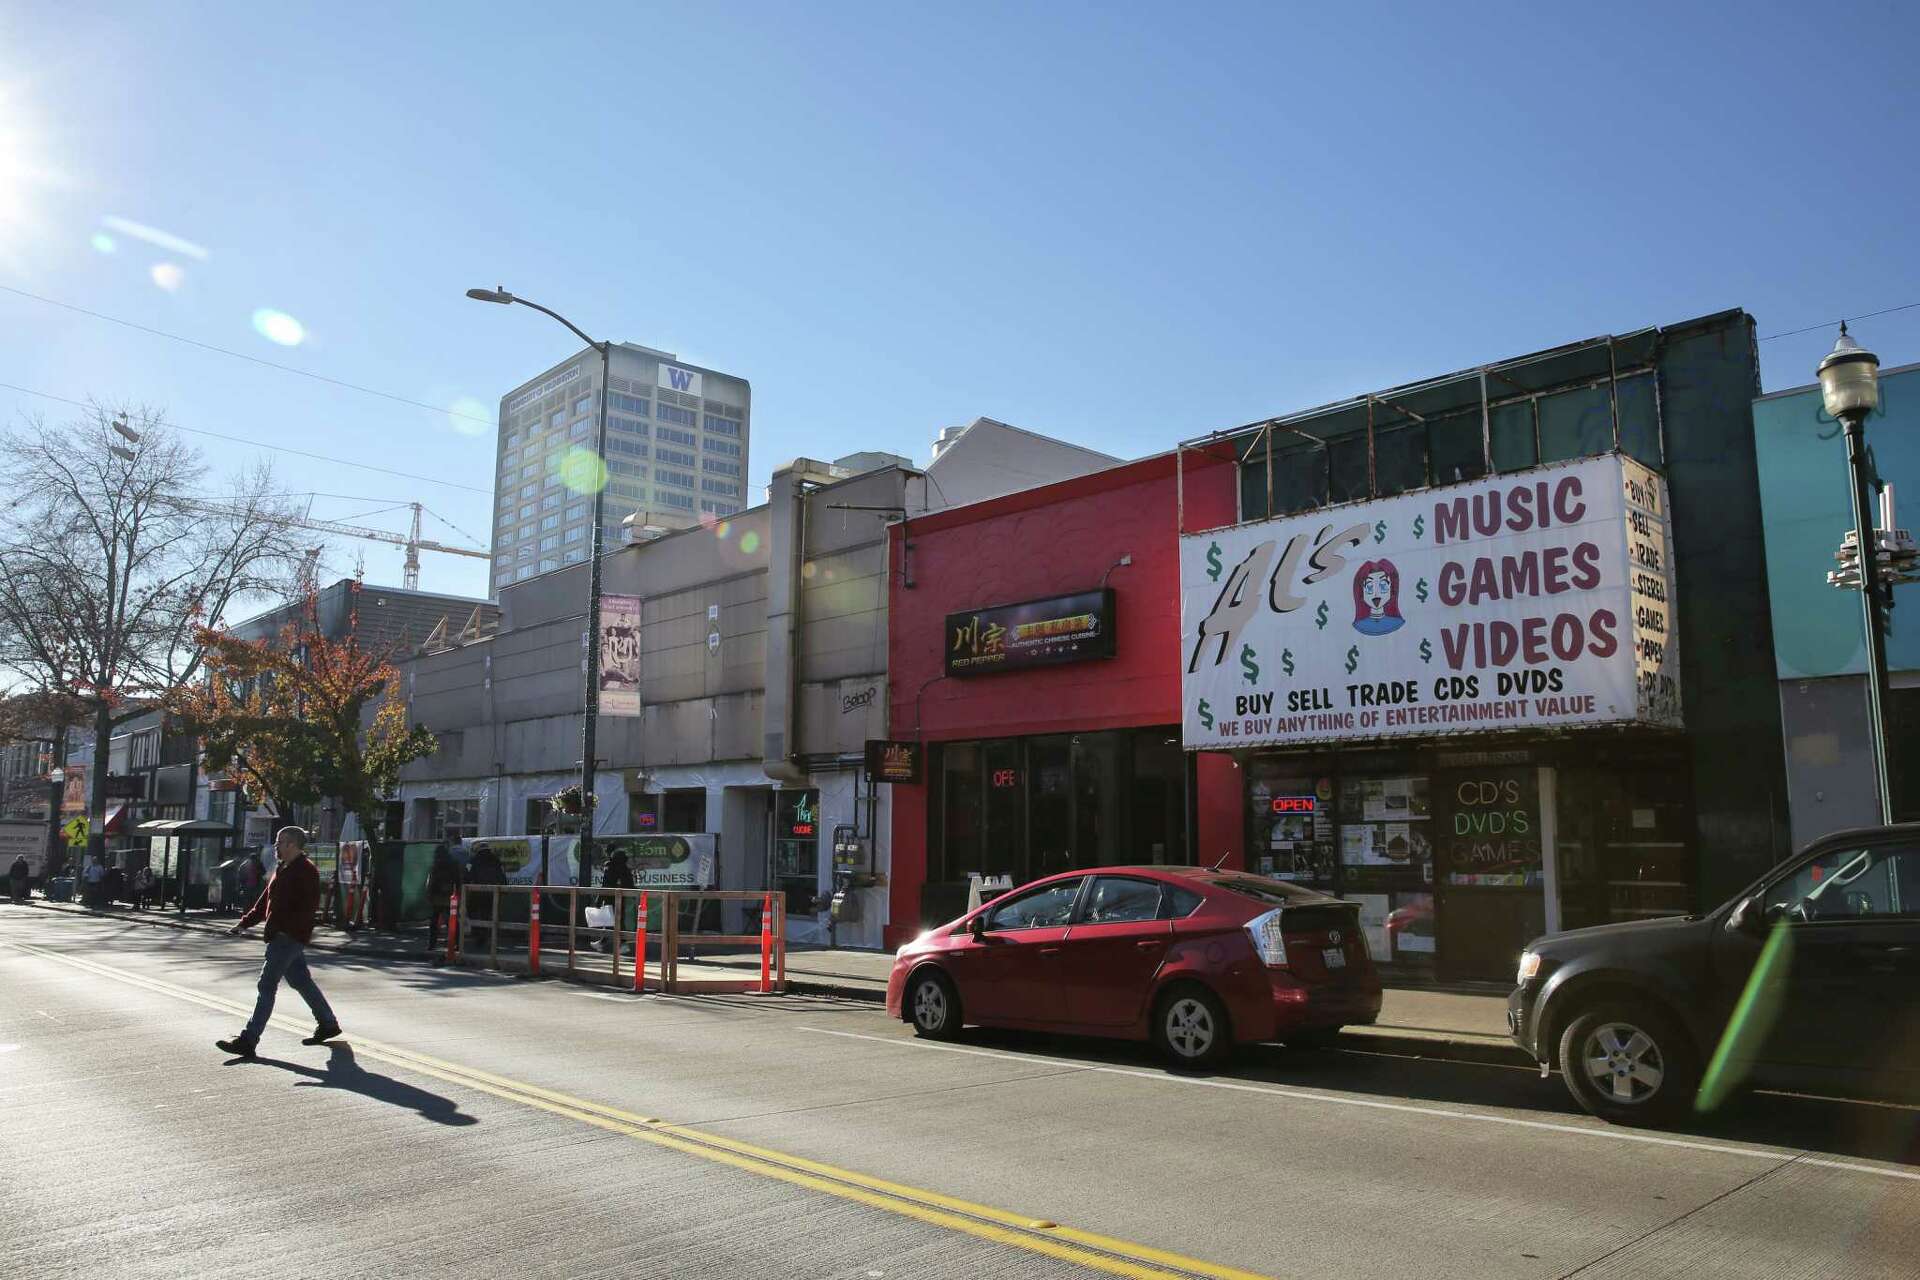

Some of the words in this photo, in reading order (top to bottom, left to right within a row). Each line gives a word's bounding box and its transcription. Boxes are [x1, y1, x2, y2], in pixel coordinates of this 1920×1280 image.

[667, 368, 693, 391] W
[1434, 476, 1586, 544] MUSIC
[1632, 510, 1650, 537] SELL
[1635, 542, 1659, 571] TRADE
[1438, 542, 1600, 606] GAMES
[1637, 575, 1665, 603] STEREO
[1638, 607, 1664, 633] GAMES
[1440, 609, 1617, 670] VIDEOS
[1640, 638, 1663, 664] TAPES
[1236, 692, 1274, 716] BUY
[1288, 688, 1333, 712] SELL
[1347, 680, 1418, 707] TRADE
[1434, 675, 1479, 700] CDS
[1497, 668, 1563, 696] DVDS
[1220, 721, 1238, 737] WE
[1245, 720, 1272, 735] BUY
[1277, 712, 1354, 734] ANYTHING
[1360, 710, 1379, 727] OF
[1386, 699, 1528, 726] ENTERTAINMENT
[1535, 695, 1597, 717] VALUE
[1273, 799, 1313, 811] OPEN
[1458, 779, 1519, 805] CD'S
[1455, 810, 1529, 835] DVD'S
